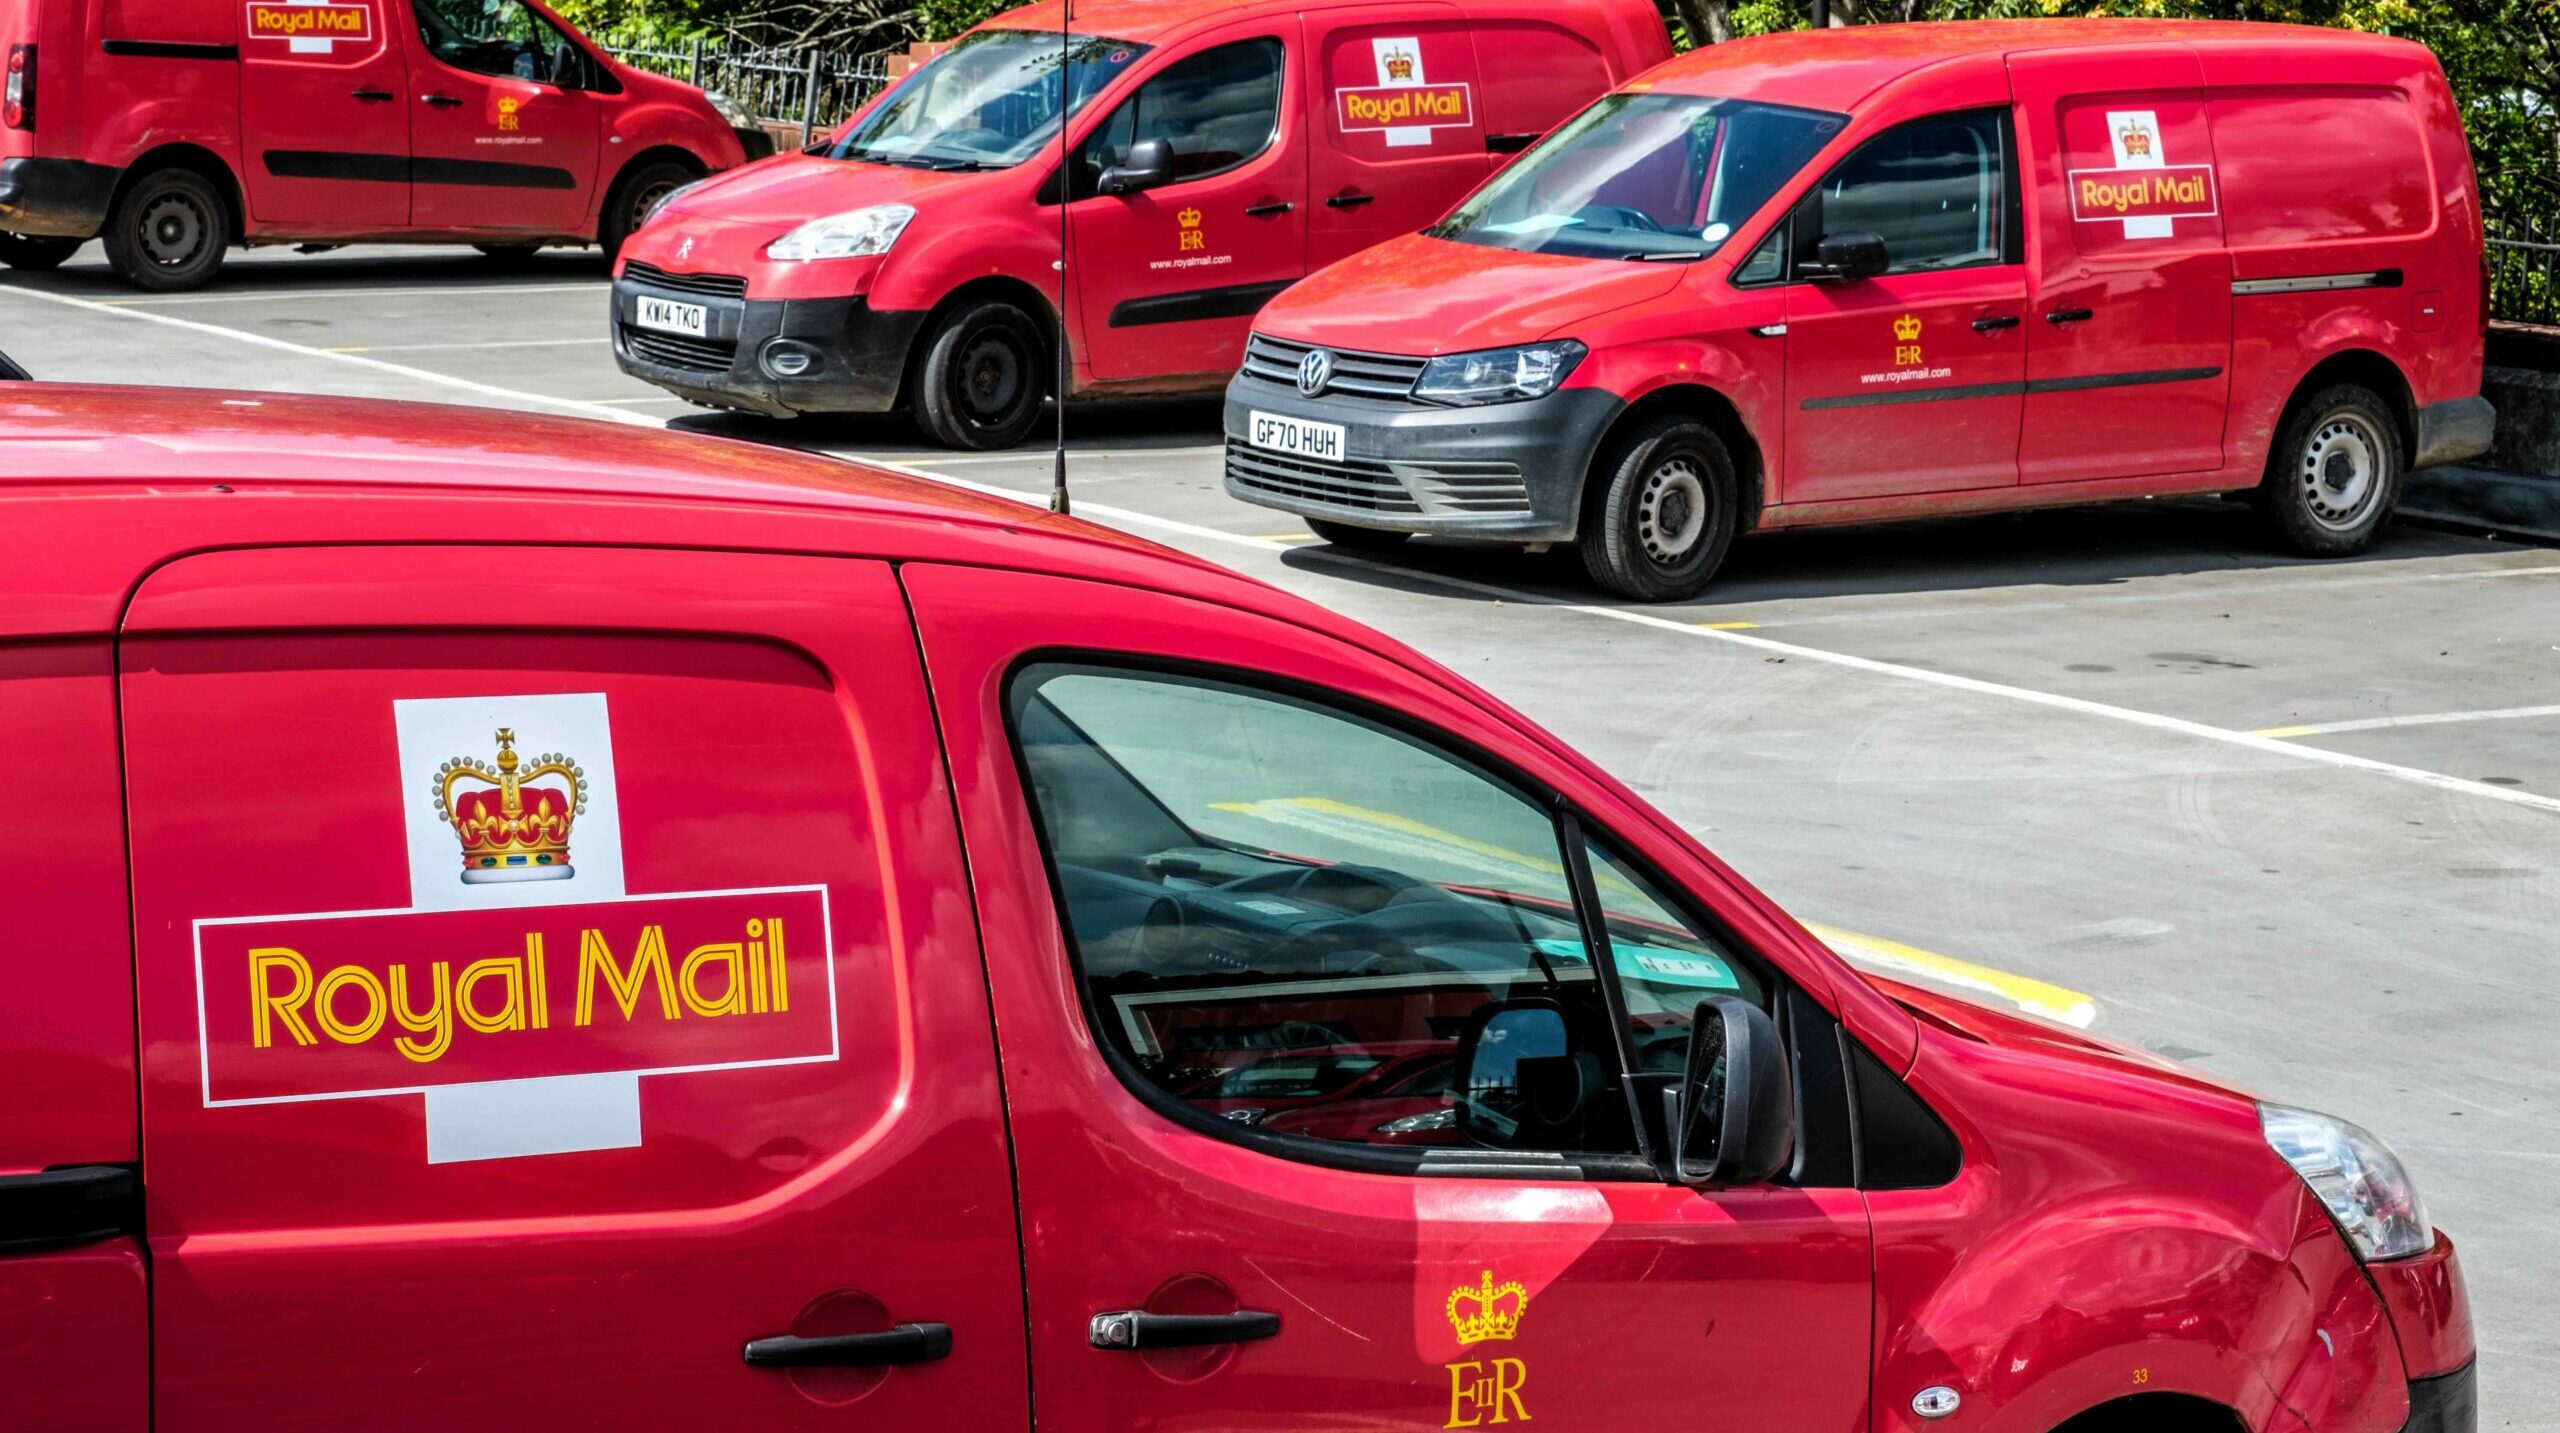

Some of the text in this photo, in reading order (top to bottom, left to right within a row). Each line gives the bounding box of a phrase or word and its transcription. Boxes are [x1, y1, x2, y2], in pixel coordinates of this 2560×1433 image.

[256, 8, 360, 33] Royal Mail
[1347, 91, 1461, 123] Royal Mail
[2081, 175, 2205, 212] Royal Mail
[1150, 255, 1232, 269] www.royalmail.com
[646, 301, 671, 325] KW14
[1861, 367, 1951, 384] www.royalmail.com
[1257, 418, 1336, 456] GF70 HUH
[248, 917, 790, 1063] Royal Mail
[2132, 1368, 2148, 1384] 33
